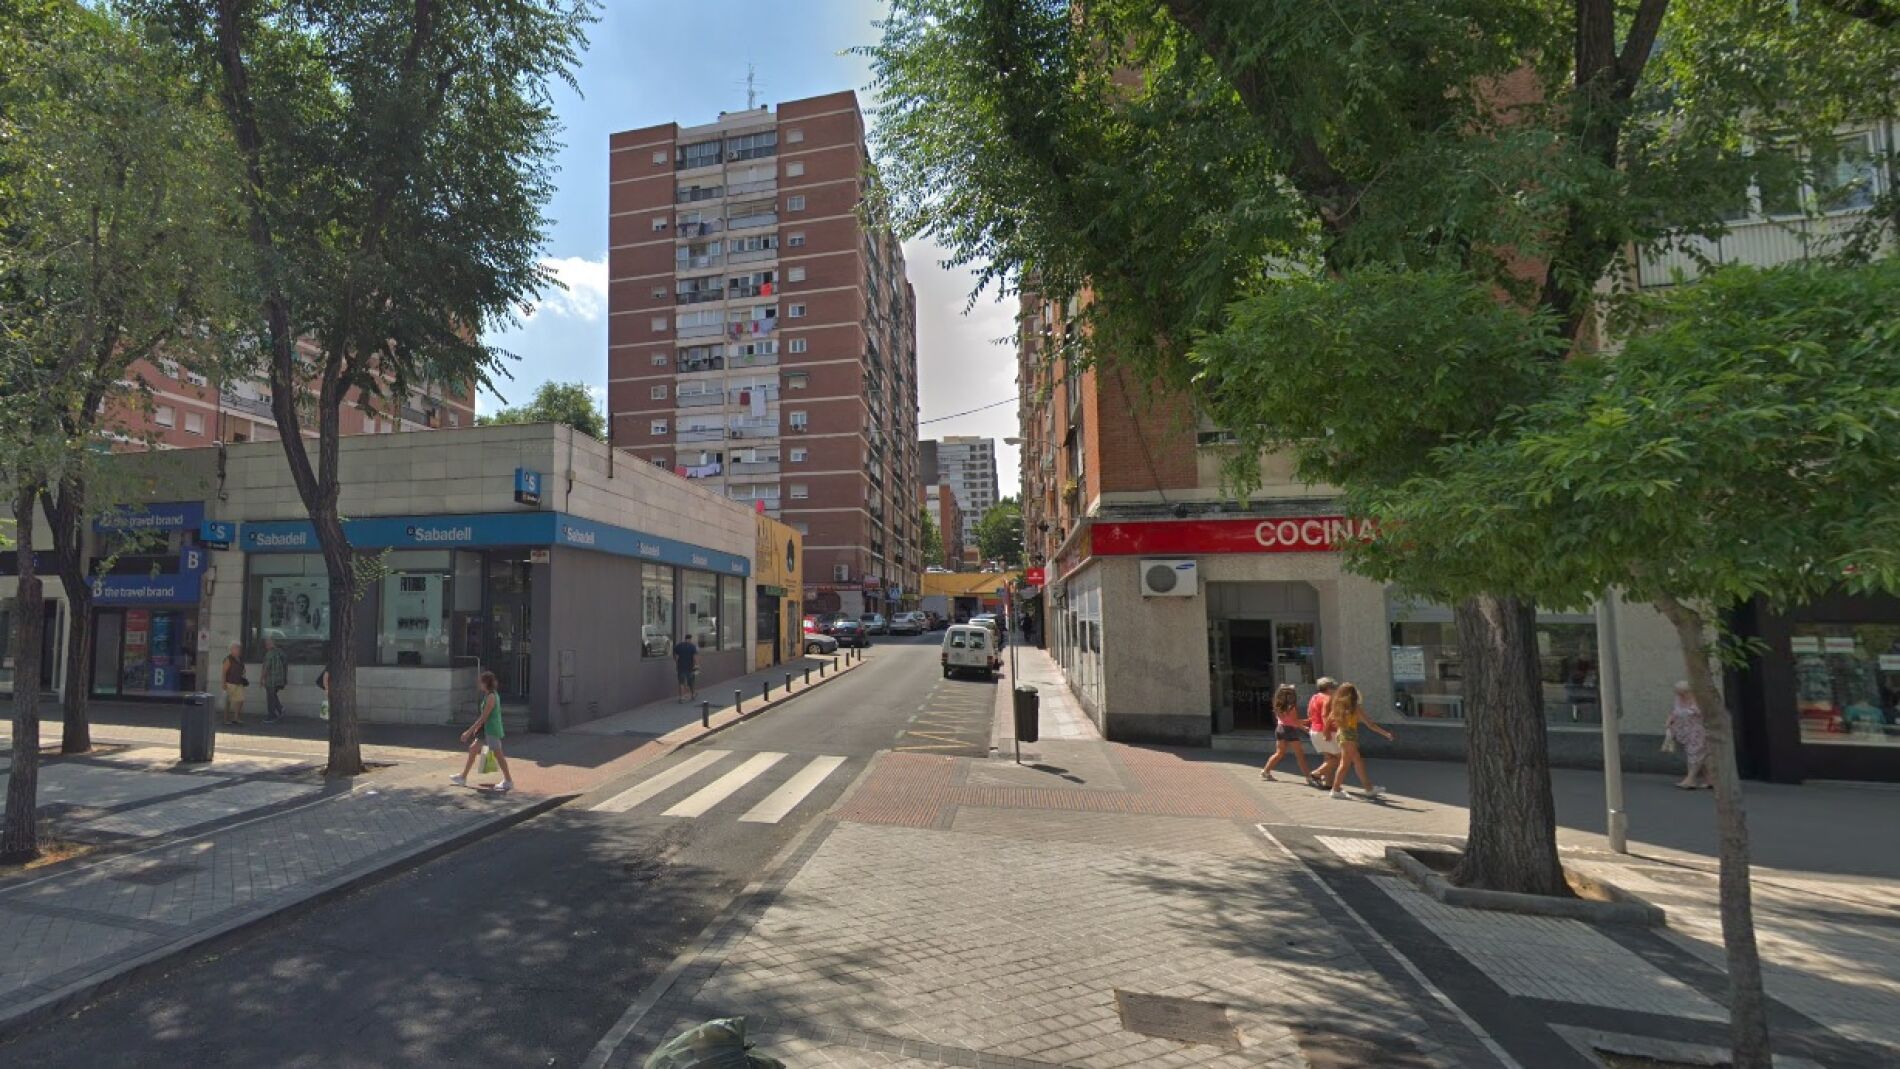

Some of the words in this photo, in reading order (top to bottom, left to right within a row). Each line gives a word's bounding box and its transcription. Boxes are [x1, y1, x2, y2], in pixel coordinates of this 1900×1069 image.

[155, 514, 183, 525] brand
[215, 525, 225, 540] S
[256, 531, 307, 545] Sabadell
[415, 527, 472, 541] Sabadell
[567, 526, 595, 545] Sabadell
[188, 551, 199, 569] B
[119, 584, 146, 598] travel
[147, 584, 174, 597] brand
[154, 668, 165, 686] B
